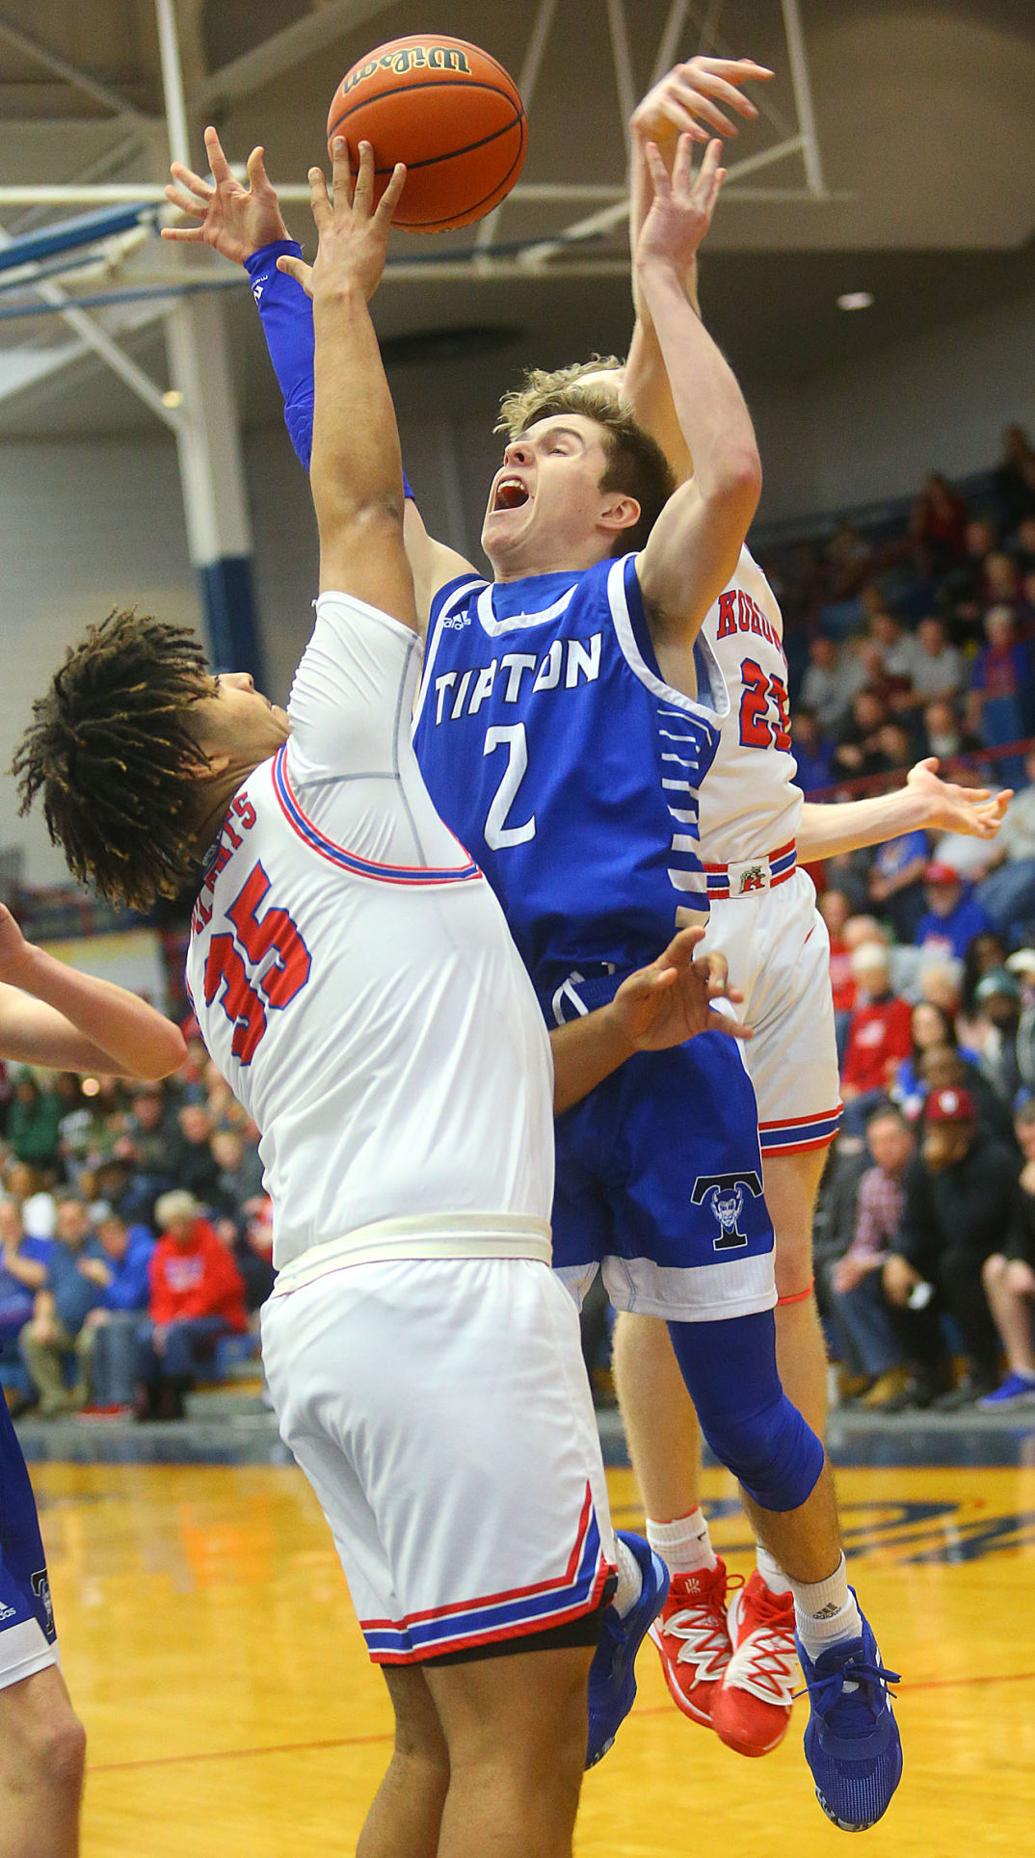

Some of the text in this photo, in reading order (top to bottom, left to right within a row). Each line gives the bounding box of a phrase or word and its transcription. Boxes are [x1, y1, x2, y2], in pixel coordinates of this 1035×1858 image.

[343, 46, 472, 95] Wilson
[435, 632, 602, 726] TIPTON
[483, 721, 536, 851] 2
[203, 858, 312, 1067] 35
